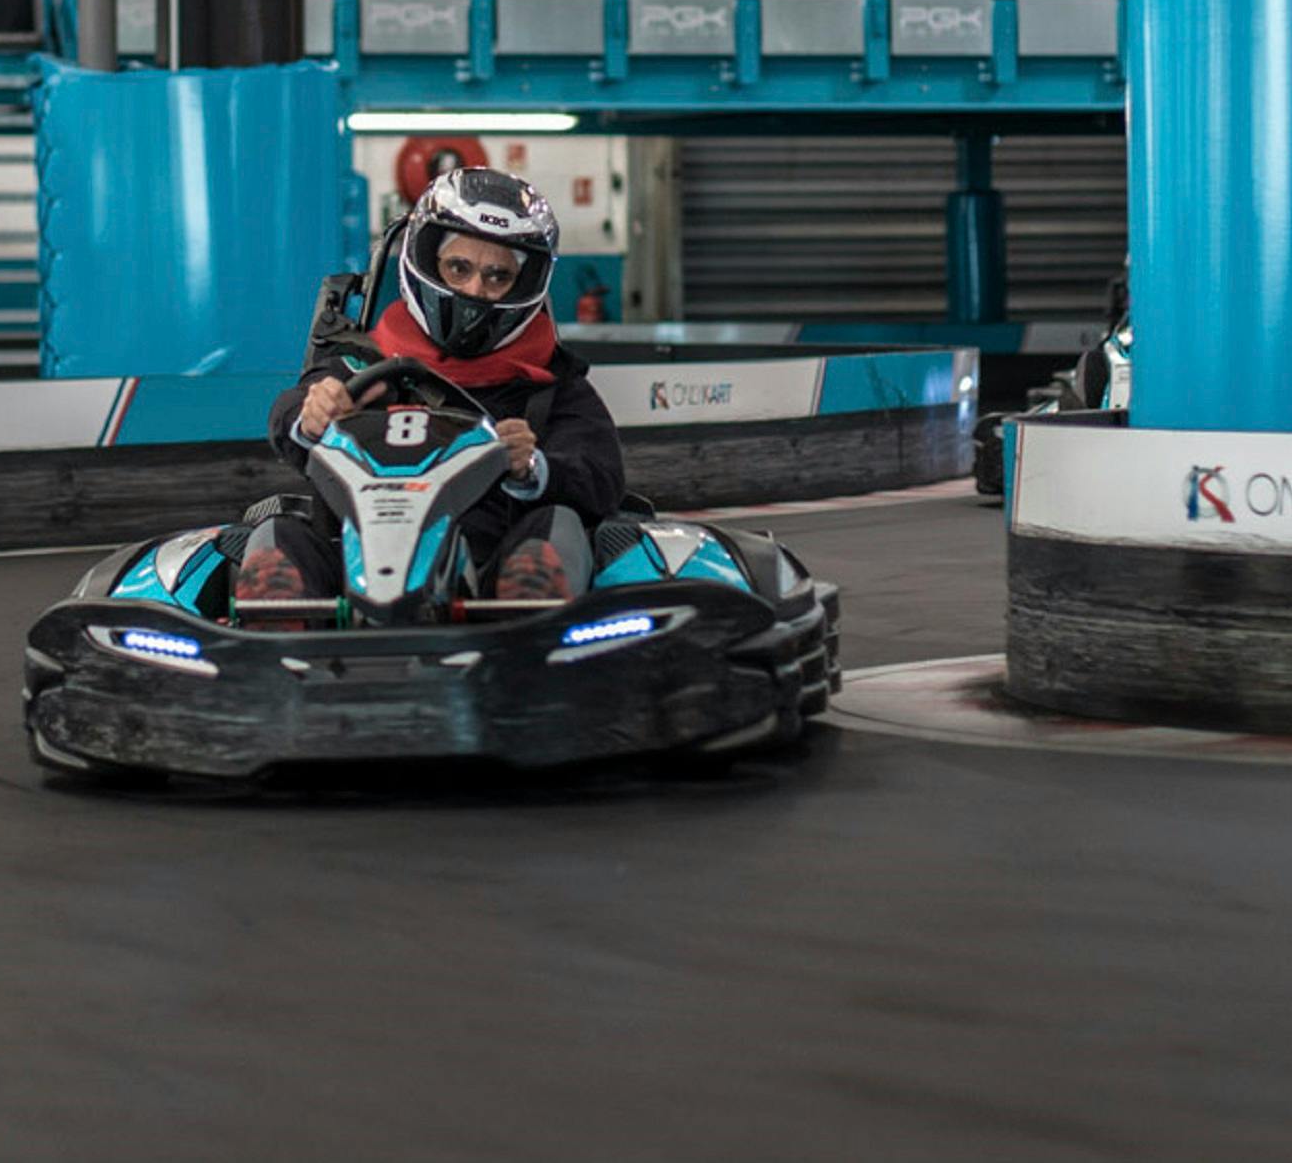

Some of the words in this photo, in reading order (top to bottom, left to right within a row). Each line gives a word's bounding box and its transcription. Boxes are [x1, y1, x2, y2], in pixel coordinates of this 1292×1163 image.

[641, 5, 727, 29] PGK
[899, 6, 983, 30] PGK
[385, 410, 430, 447] 8
